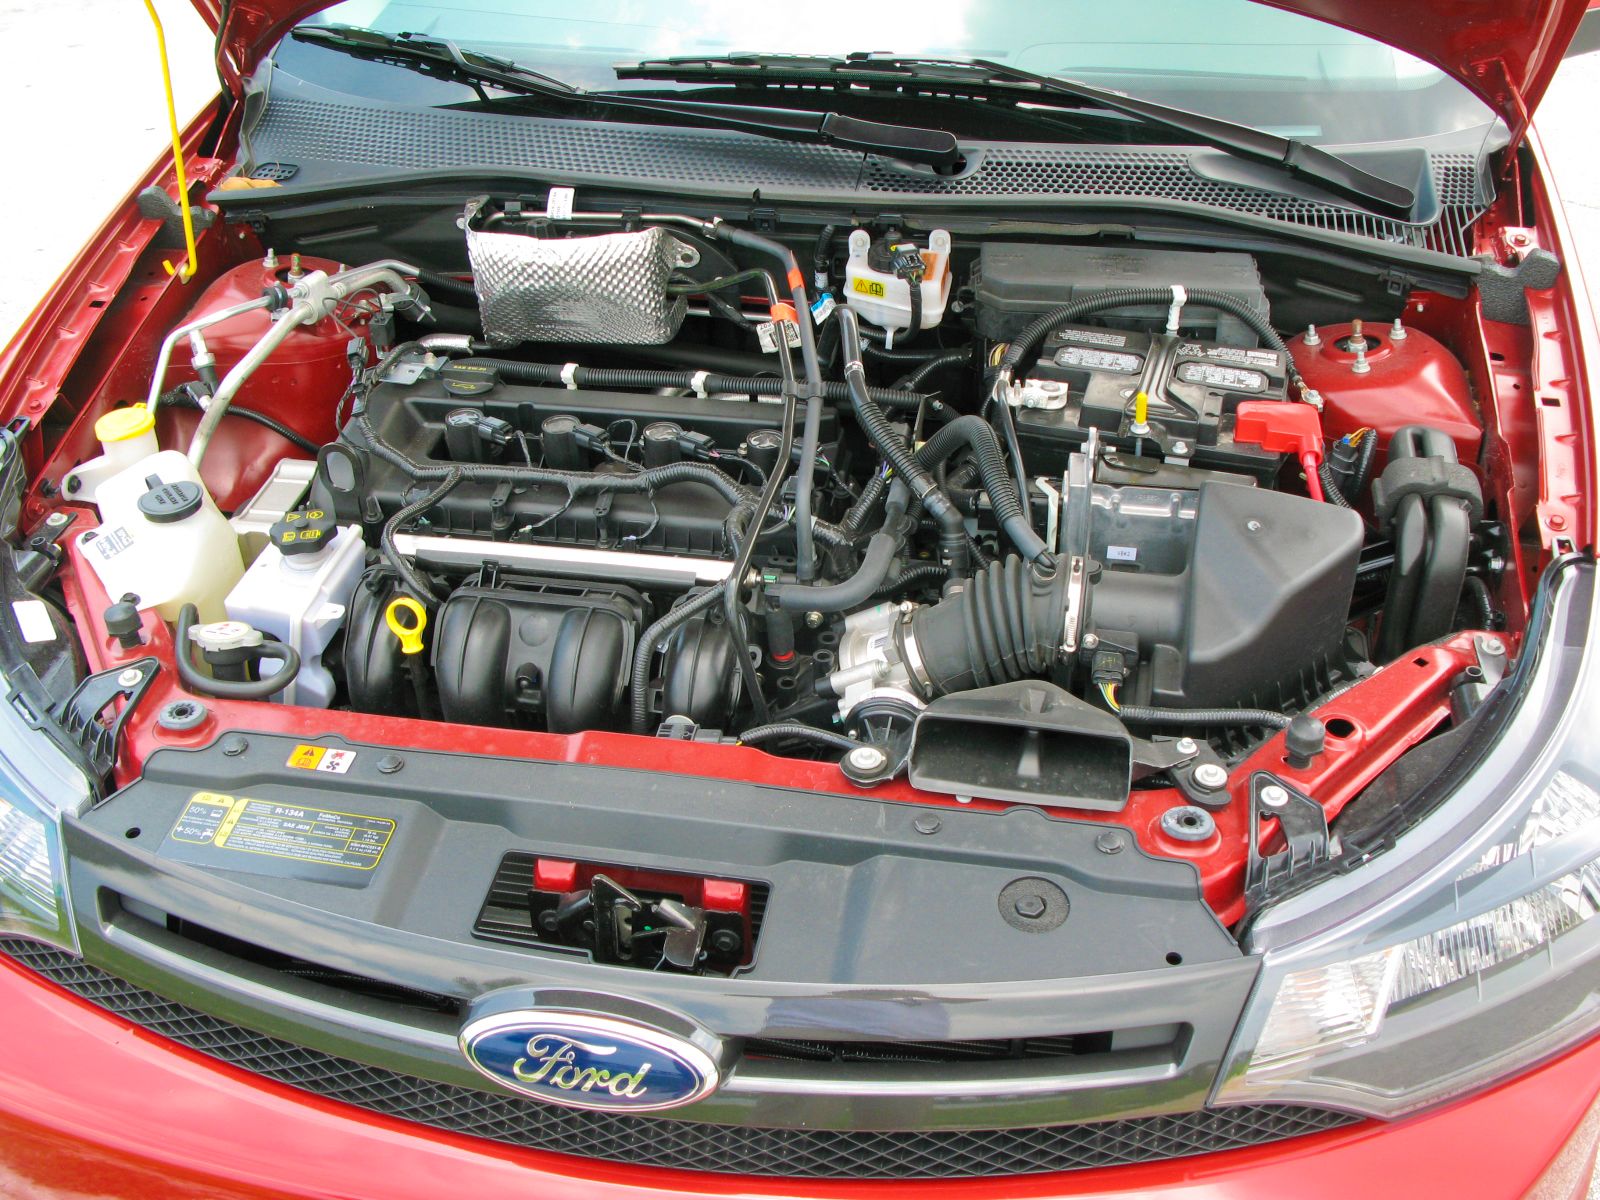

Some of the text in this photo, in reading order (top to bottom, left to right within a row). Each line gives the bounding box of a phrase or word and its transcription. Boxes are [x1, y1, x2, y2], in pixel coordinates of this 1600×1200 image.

[189, 806, 207, 814] 50%
[275, 807, 304, 818] R-134A
[513, 1034, 652, 1098] Ford
